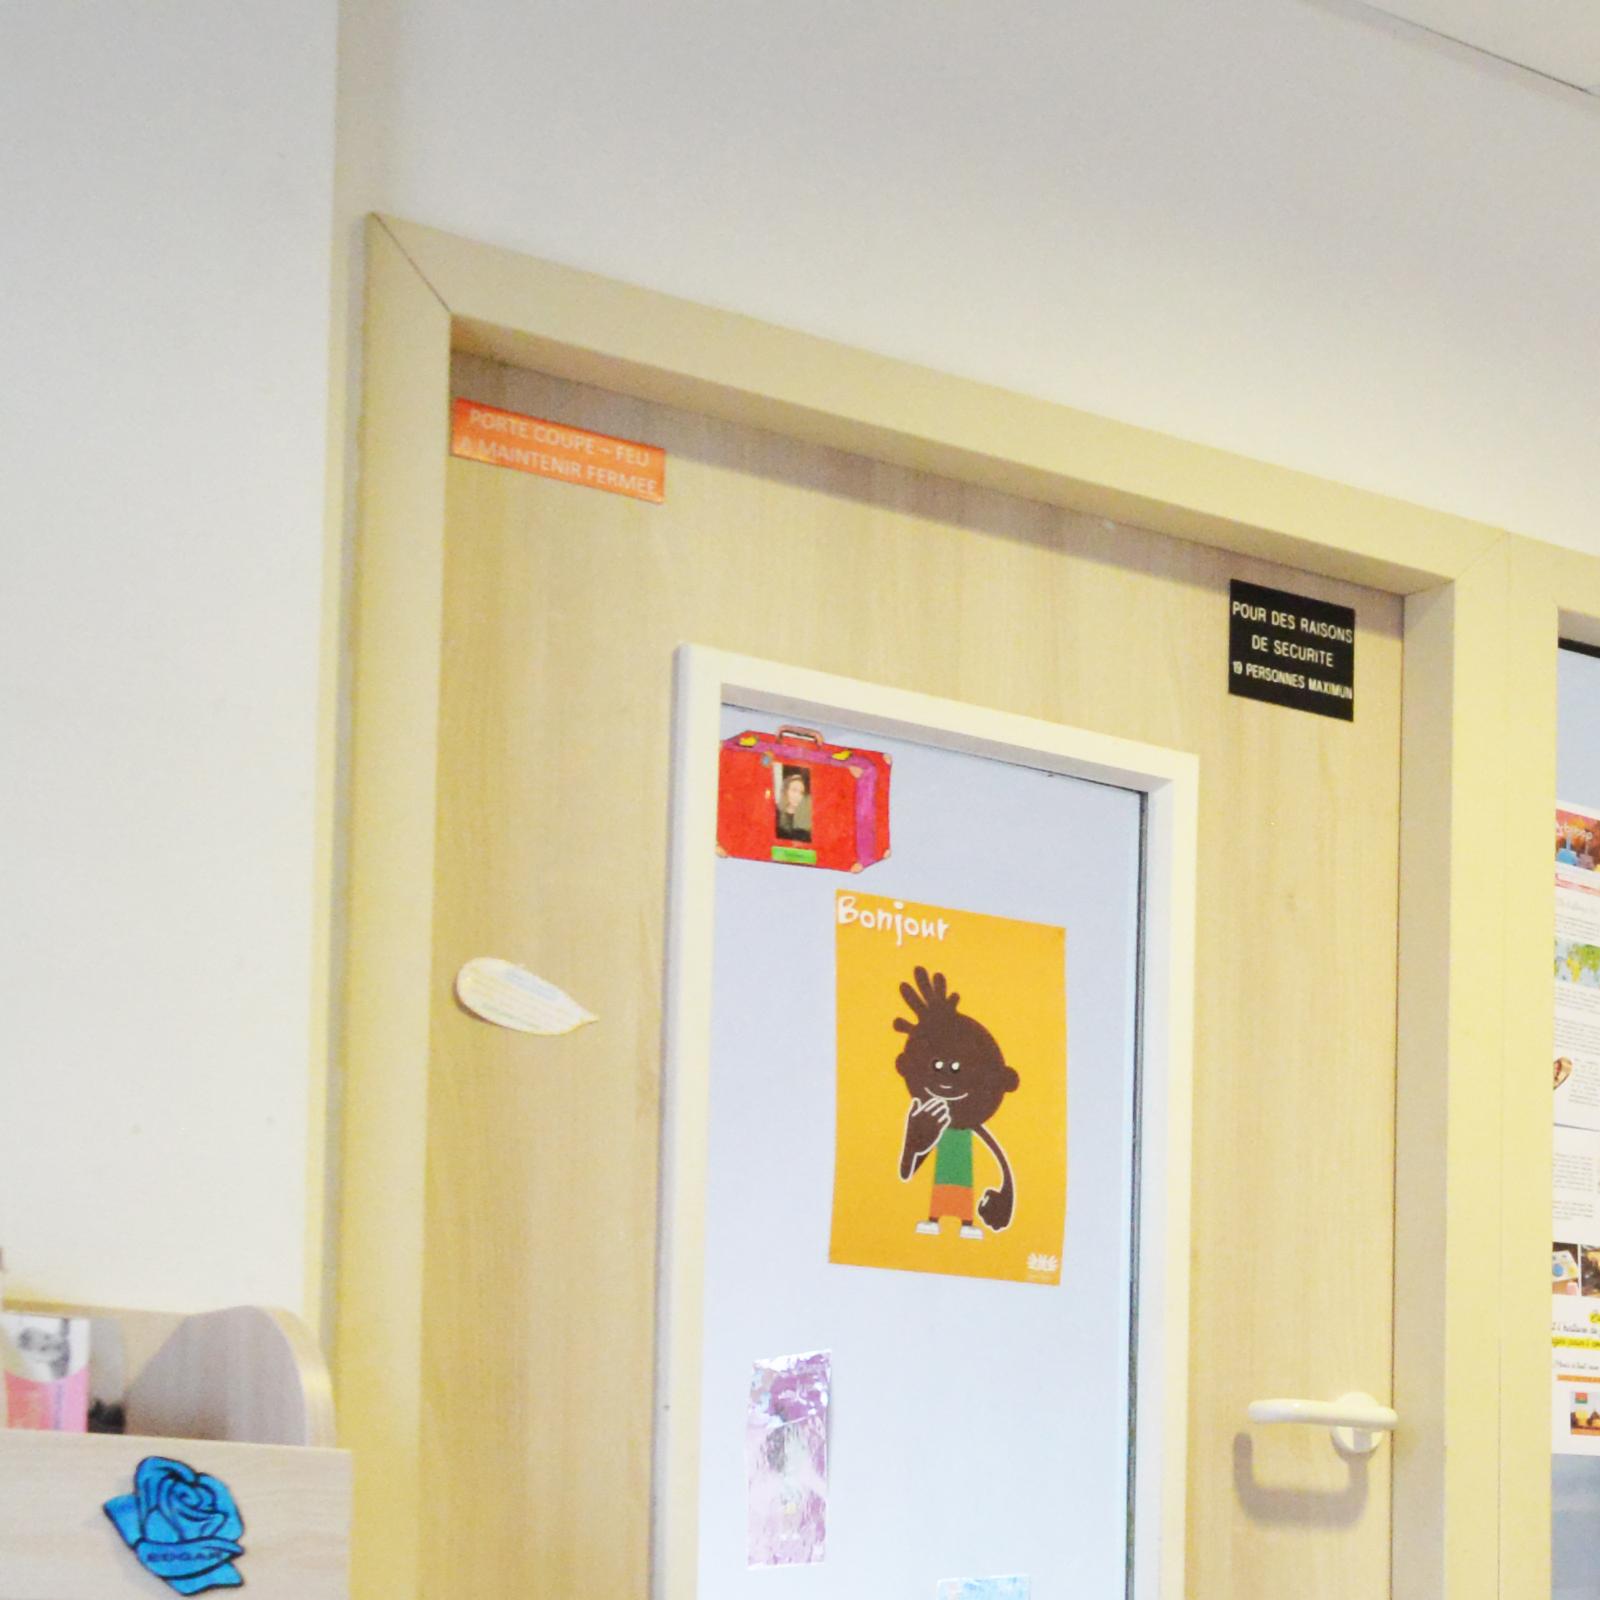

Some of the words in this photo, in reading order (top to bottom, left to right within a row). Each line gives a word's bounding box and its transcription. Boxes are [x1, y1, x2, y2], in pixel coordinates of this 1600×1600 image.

[469, 409, 529, 438] PORTE
[533, 426, 595, 455] COUPE
[615, 445, 650, 468] FEU
[477, 439, 582, 477] MAINTENIR
[1232, 601, 1266, 623] POUR
[1271, 610, 1296, 630] DES
[1300, 617, 1353, 644] RAISONS
[1251, 634, 1269, 652] DE
[1273, 640, 1334, 668] SECURITE
[1246, 663, 1306, 690] PERSONNES
[837, 895, 950, 947] Bonjour
